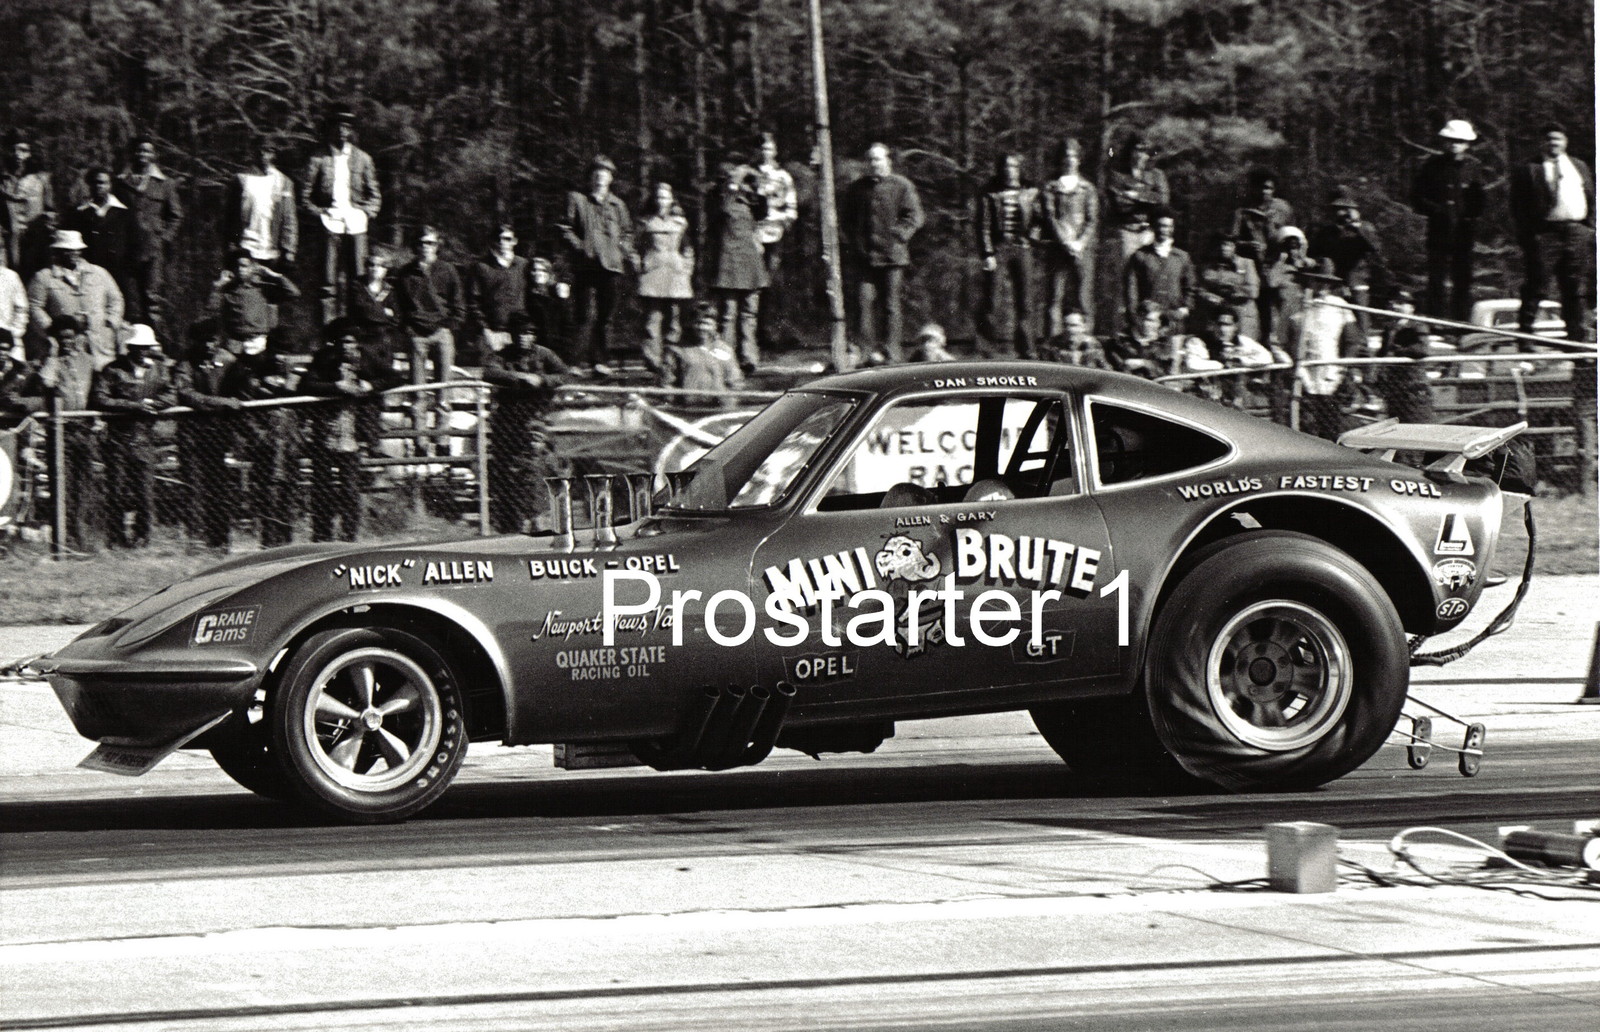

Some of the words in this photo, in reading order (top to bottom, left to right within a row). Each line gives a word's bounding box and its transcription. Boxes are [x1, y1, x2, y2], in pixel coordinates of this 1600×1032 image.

[934, 378, 966, 388] DAN
[976, 376, 1038, 387] SMOKER
[1177, 475, 1263, 500] WORLD'S
[1280, 475, 1375, 492] FASTEST
[1390, 479, 1442, 498] OPEL
[895, 516, 931, 528] ALLEN
[940, 514, 950, 523] &
[957, 511, 997, 522] GARY
[333, 559, 416, 587] "NICK"
[423, 560, 494, 584] ALLEN
[530, 558, 597, 578] BUICK
[625, 554, 680, 572] OPEL
[763, 547, 877, 613] MINI
[955, 528, 1101, 591] BRUTE
[1440, 600, 1465, 616] STP
[533, 610, 602, 641] Newport
[556, 649, 616, 668] QUAKER
[621, 646, 666, 665] STATE
[1026, 635, 1062, 656] GT
[571, 666, 621, 681] RACING
[627, 665, 650, 678] OIL
[795, 655, 854, 679] OPEL
